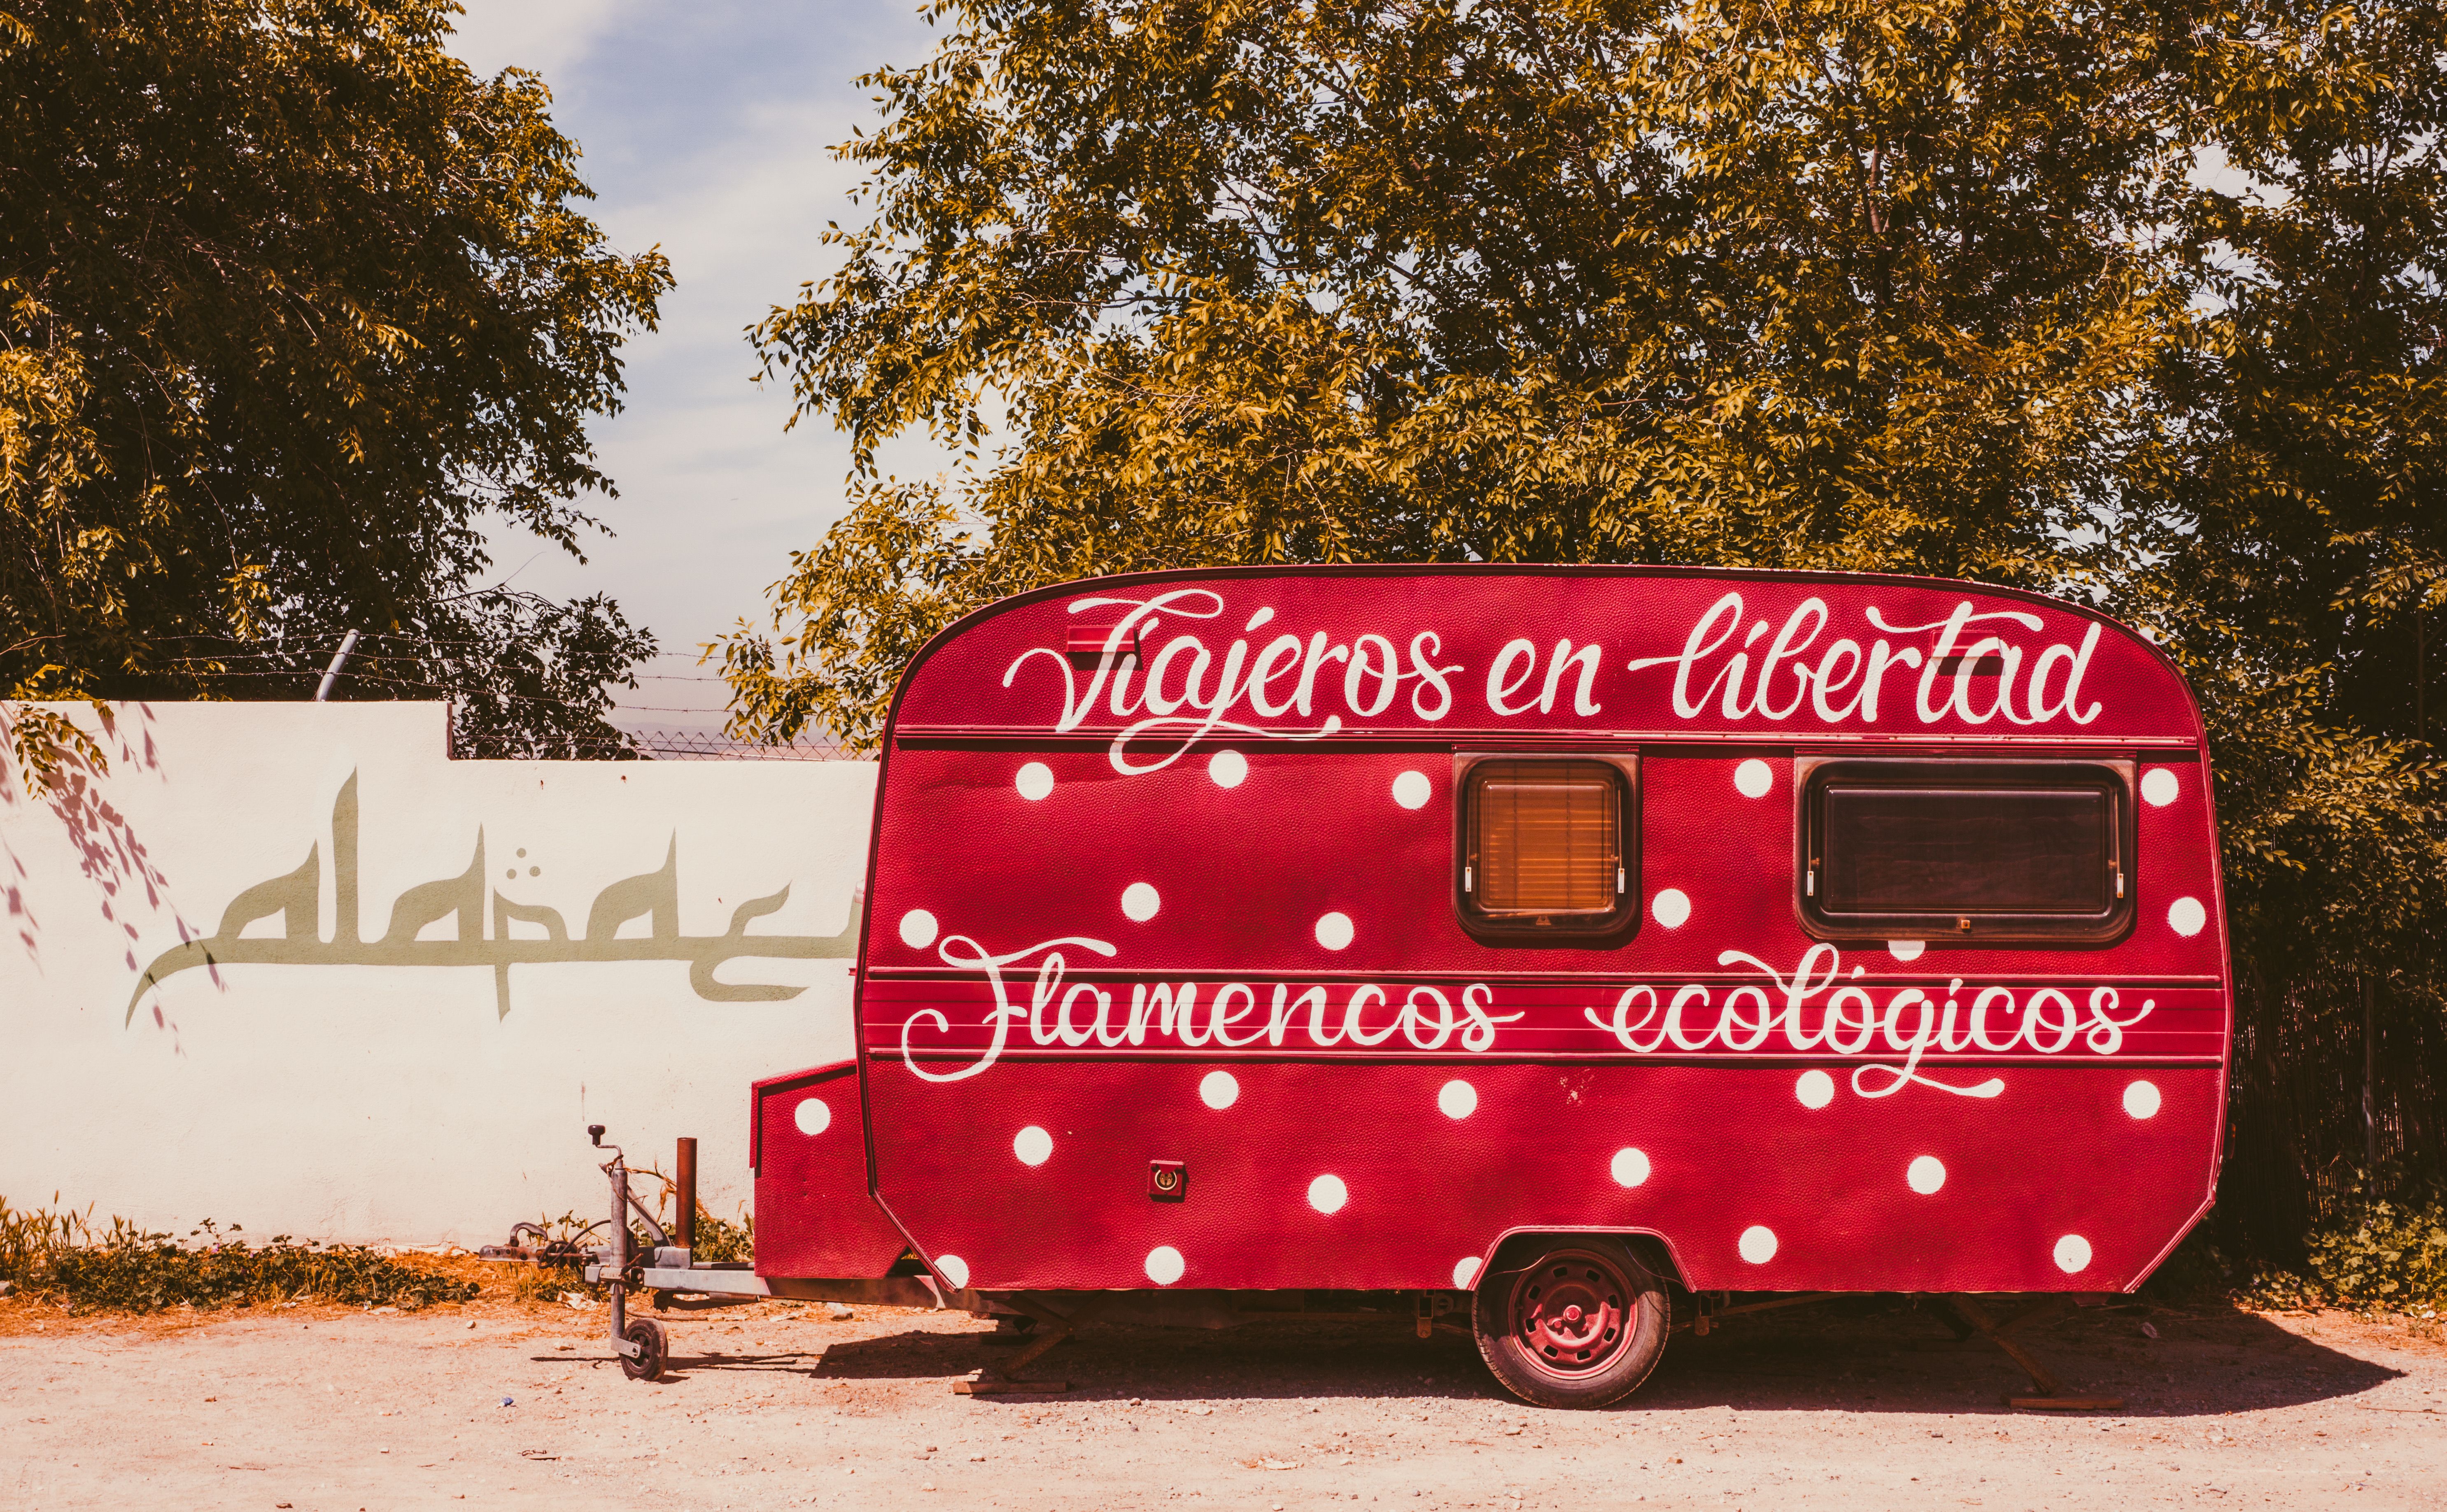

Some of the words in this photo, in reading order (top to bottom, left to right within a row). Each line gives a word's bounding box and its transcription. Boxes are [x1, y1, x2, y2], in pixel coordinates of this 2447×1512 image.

[1003, 589, 1464, 775] Viajeros
[1487, 639, 1601, 716] en
[1628, 592, 2102, 725] libertad
[901, 935, 1525, 1082] Flamencos
[1584, 943, 2155, 1098] ecológicos
